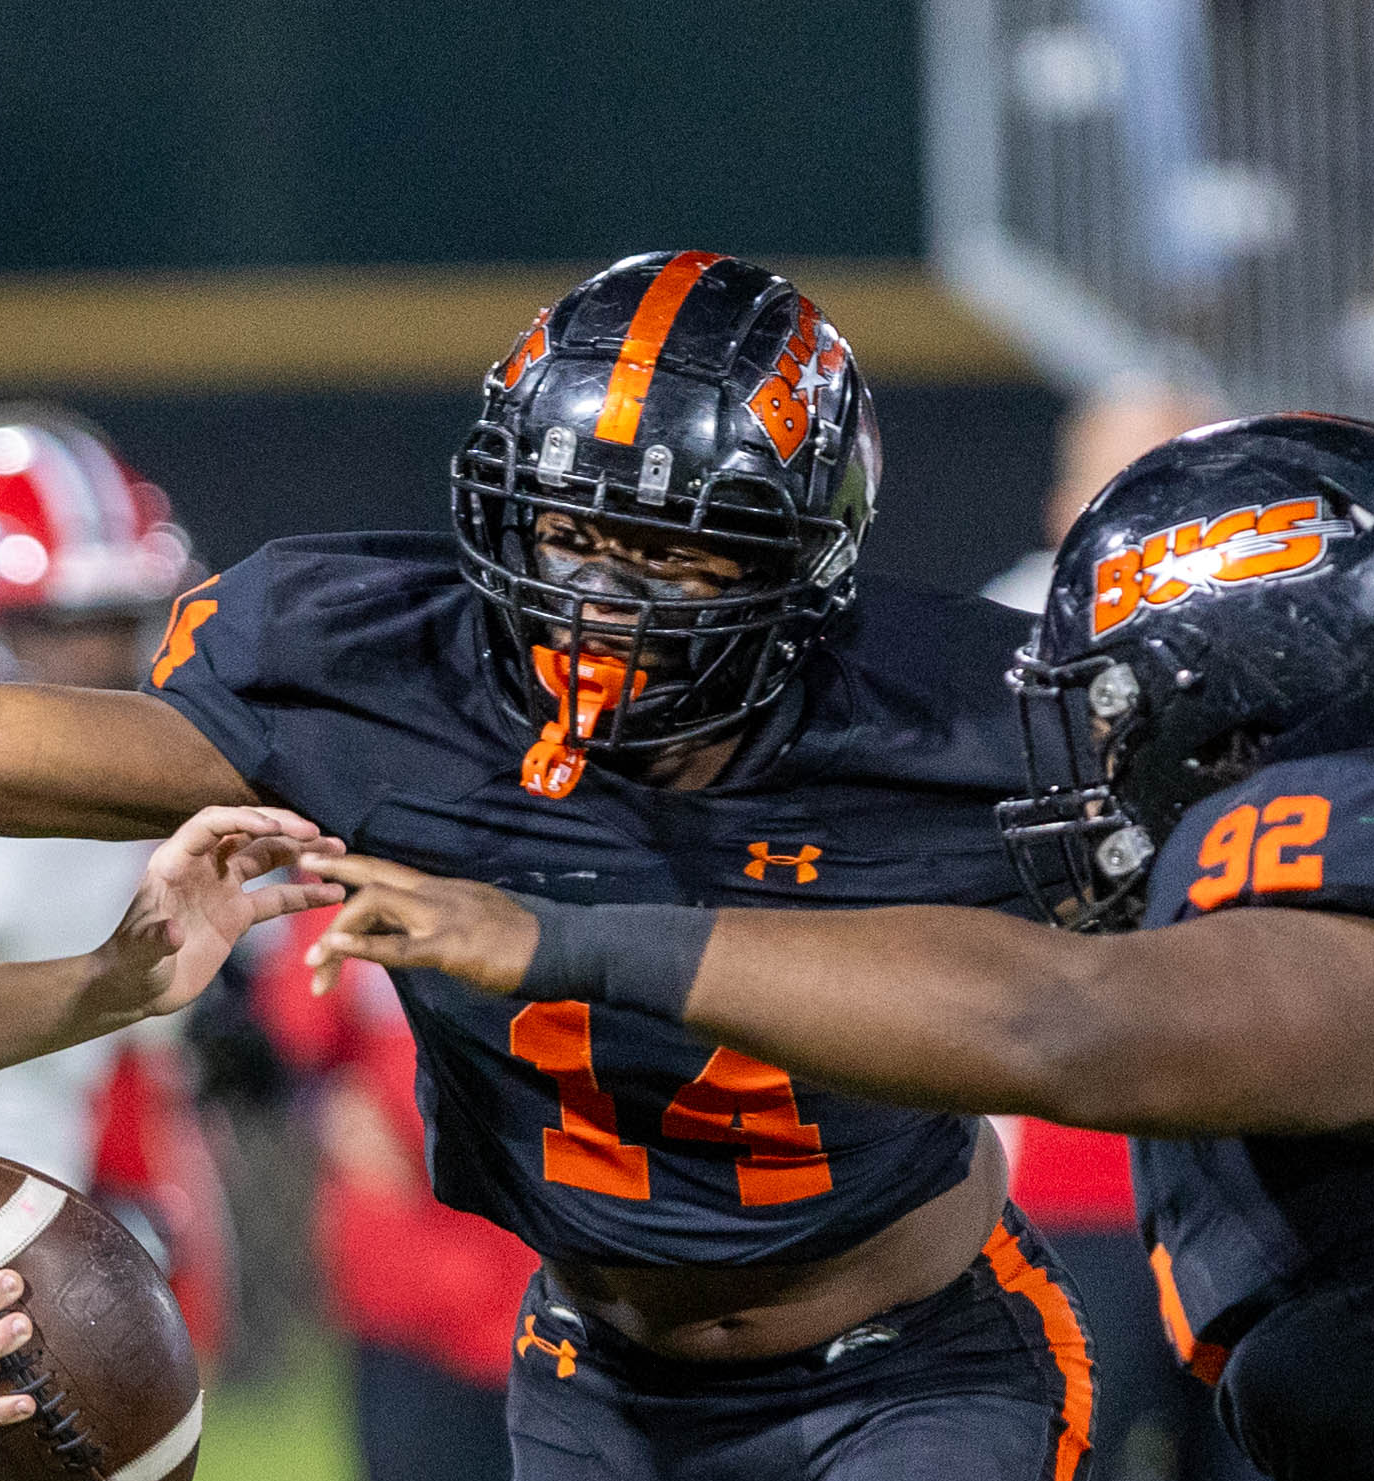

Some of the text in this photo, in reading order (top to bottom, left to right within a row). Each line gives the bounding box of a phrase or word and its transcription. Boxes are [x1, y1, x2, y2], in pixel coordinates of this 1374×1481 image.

[1091, 495, 1356, 642] BUCS
[1188, 794, 1332, 911] 92
[510, 1000, 833, 1206] 14
